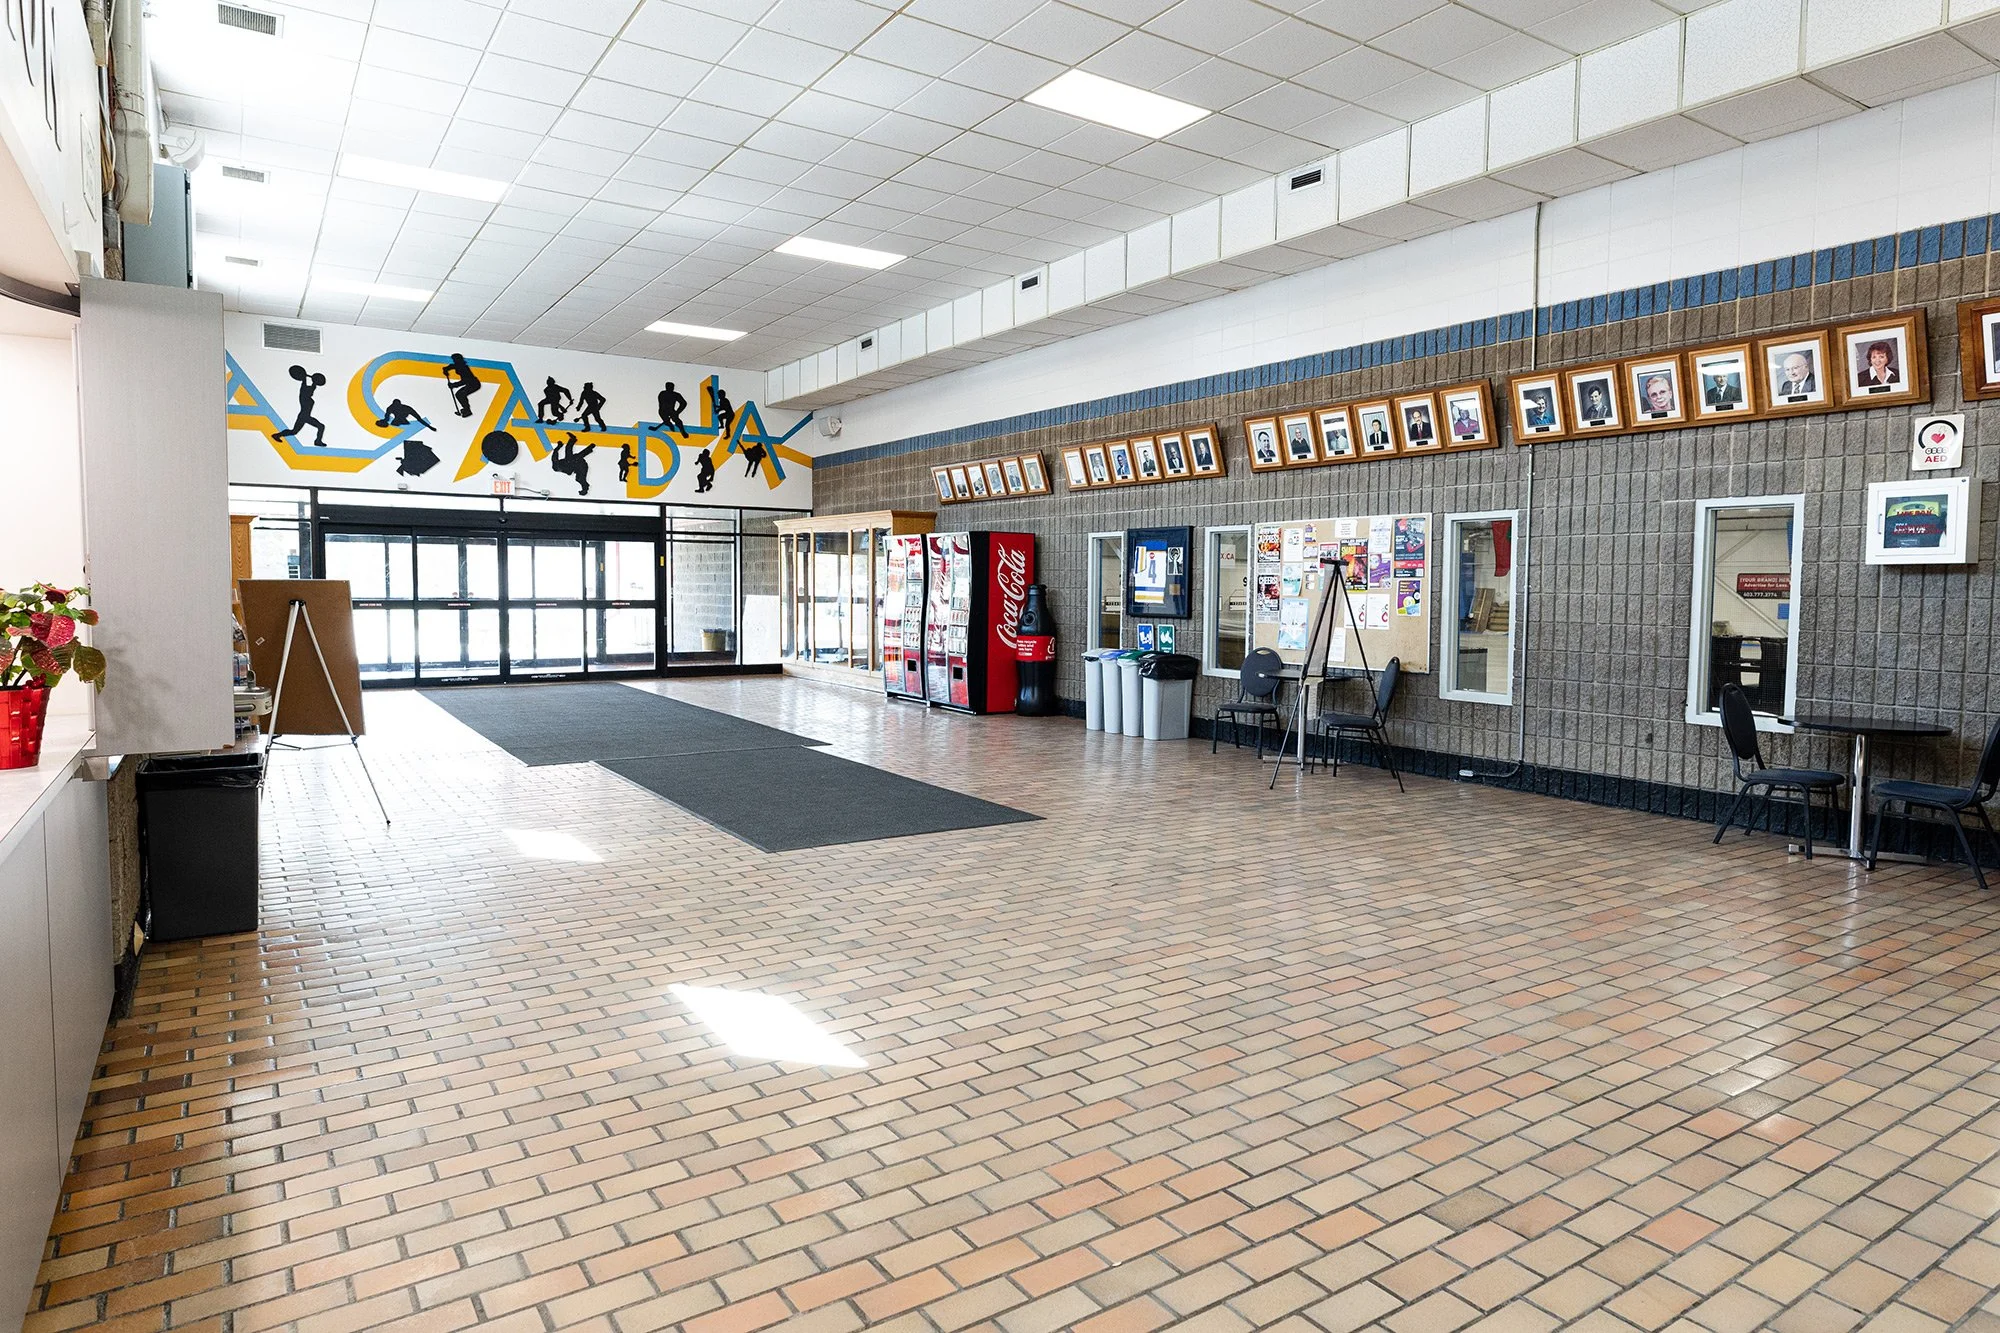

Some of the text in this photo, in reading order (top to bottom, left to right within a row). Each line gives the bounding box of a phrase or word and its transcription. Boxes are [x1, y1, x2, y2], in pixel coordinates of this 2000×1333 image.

[1924, 454, 1948, 463] AED
[493, 480, 511, 493] EXIT
[996, 542, 1026, 649] Coca-Cola
